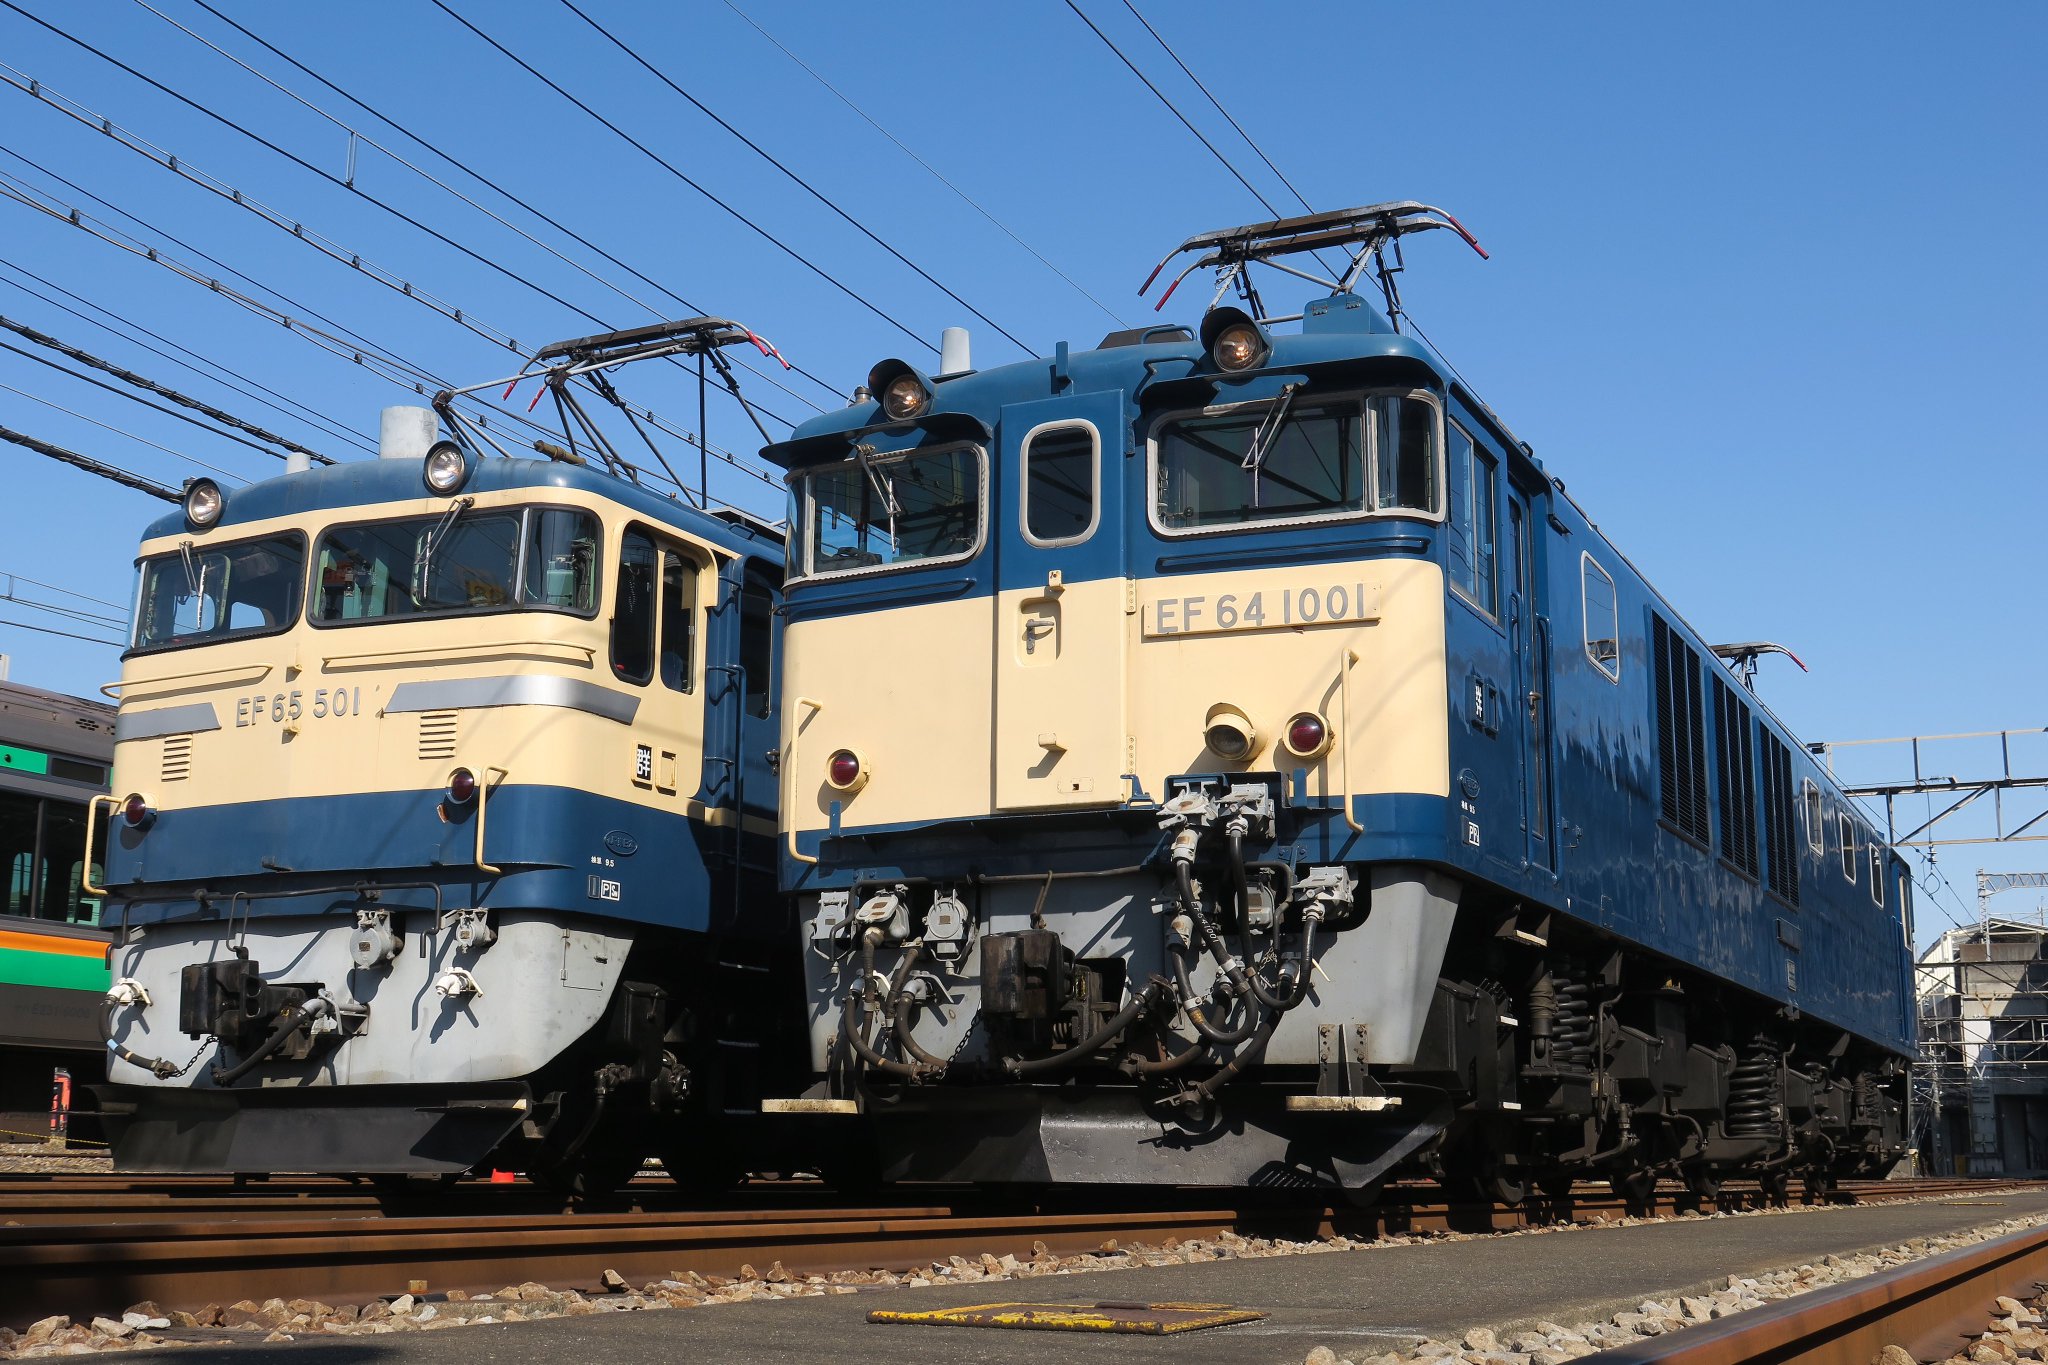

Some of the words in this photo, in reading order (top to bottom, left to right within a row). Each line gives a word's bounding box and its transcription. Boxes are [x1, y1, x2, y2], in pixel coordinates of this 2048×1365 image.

[1157, 596, 1206, 633] EF
[1216, 591, 1265, 629] 64
[1283, 583, 1364, 625] 1001
[236, 695, 266, 728] EF
[271, 690, 303, 722] 65
[313, 686, 360, 718] 501
[636, 748, 651, 777] 群
